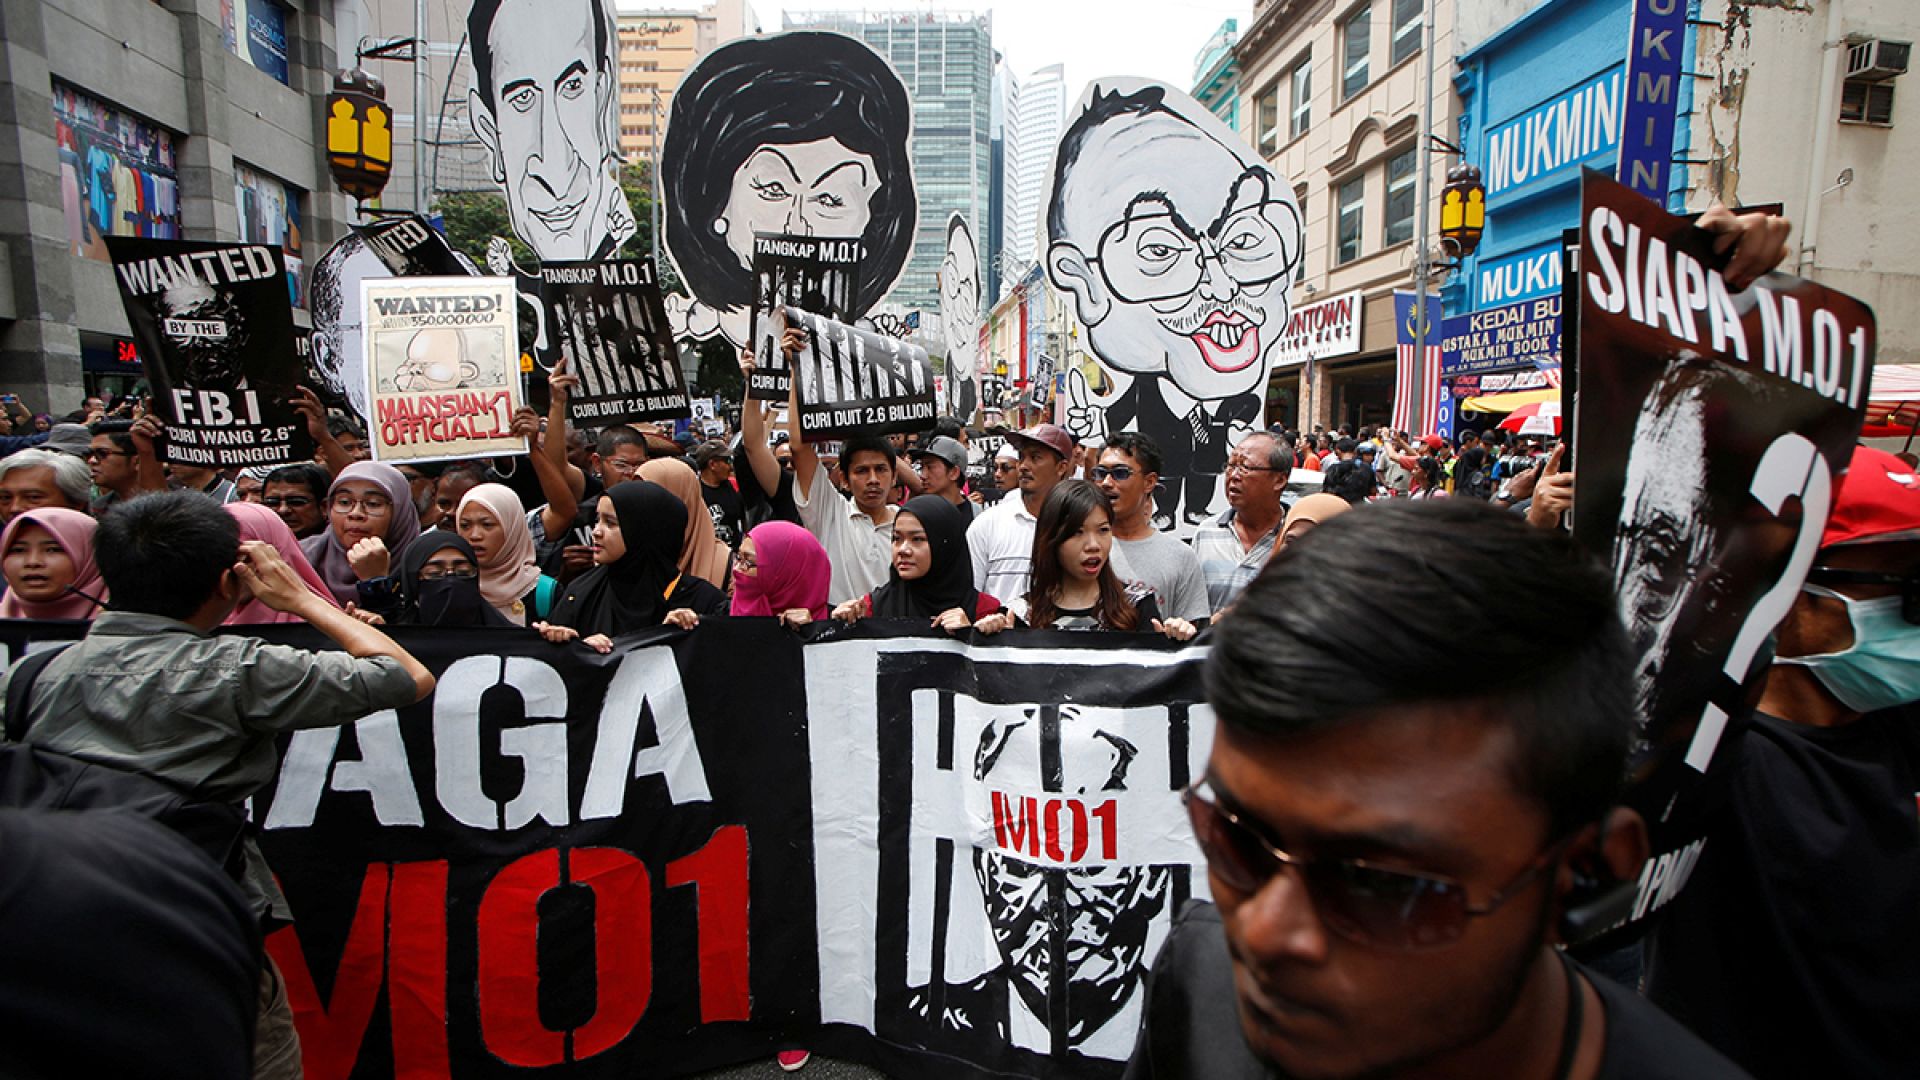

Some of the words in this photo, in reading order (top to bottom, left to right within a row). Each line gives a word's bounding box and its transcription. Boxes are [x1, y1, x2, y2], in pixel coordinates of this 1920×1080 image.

[1488, 72, 1620, 195] MUKMIN
[756, 238, 816, 258] TANGKAP
[818, 241, 860, 262] M.O.1
[117, 245, 277, 296] WANTED
[542, 268, 597, 284] TANGKAP
[600, 263, 652, 286] M.O.1
[1482, 250, 1562, 304] MUKM
[374, 294, 503, 316] WANTED!
[1285, 296, 1354, 338] WNTOWN
[1470, 304, 1526, 333] KEDAI
[1533, 296, 1562, 319] BU
[1587, 206, 1749, 362] SIAPA
[1755, 285, 1865, 409] M.O.1
[170, 321, 187, 334] BY
[191, 321, 221, 335] THE
[1442, 331, 1491, 353] USTAKA
[1496, 318, 1555, 343] MUKMIN
[119, 341, 138, 362] SA
[1461, 343, 1508, 363] MUKMIN
[1513, 336, 1550, 355] BOOK
[751, 374, 775, 390] CURI
[777, 376, 791, 391] DU
[171, 388, 262, 426] F.B.I
[377, 391, 489, 423] MALAYSIAN
[572, 402, 599, 418] CURI
[600, 400, 625, 415] DUIT
[627, 399, 645, 413] 2.6
[648, 395, 687, 410] BILLION
[802, 411, 831, 430] CURI
[834, 408, 863, 427] DUIT
[866, 406, 886, 423] 2.6
[889, 402, 933, 422] BILLION
[1439, 386, 1449, 438] BOO
[200, 428, 254, 446] WANG
[381, 416, 487, 446] OFFICIAL
[167, 444, 215, 464] BILLION
[220, 444, 291, 463] RINGGIT
[245, 645, 713, 830] AGA
[991, 790, 1118, 863] MO1
